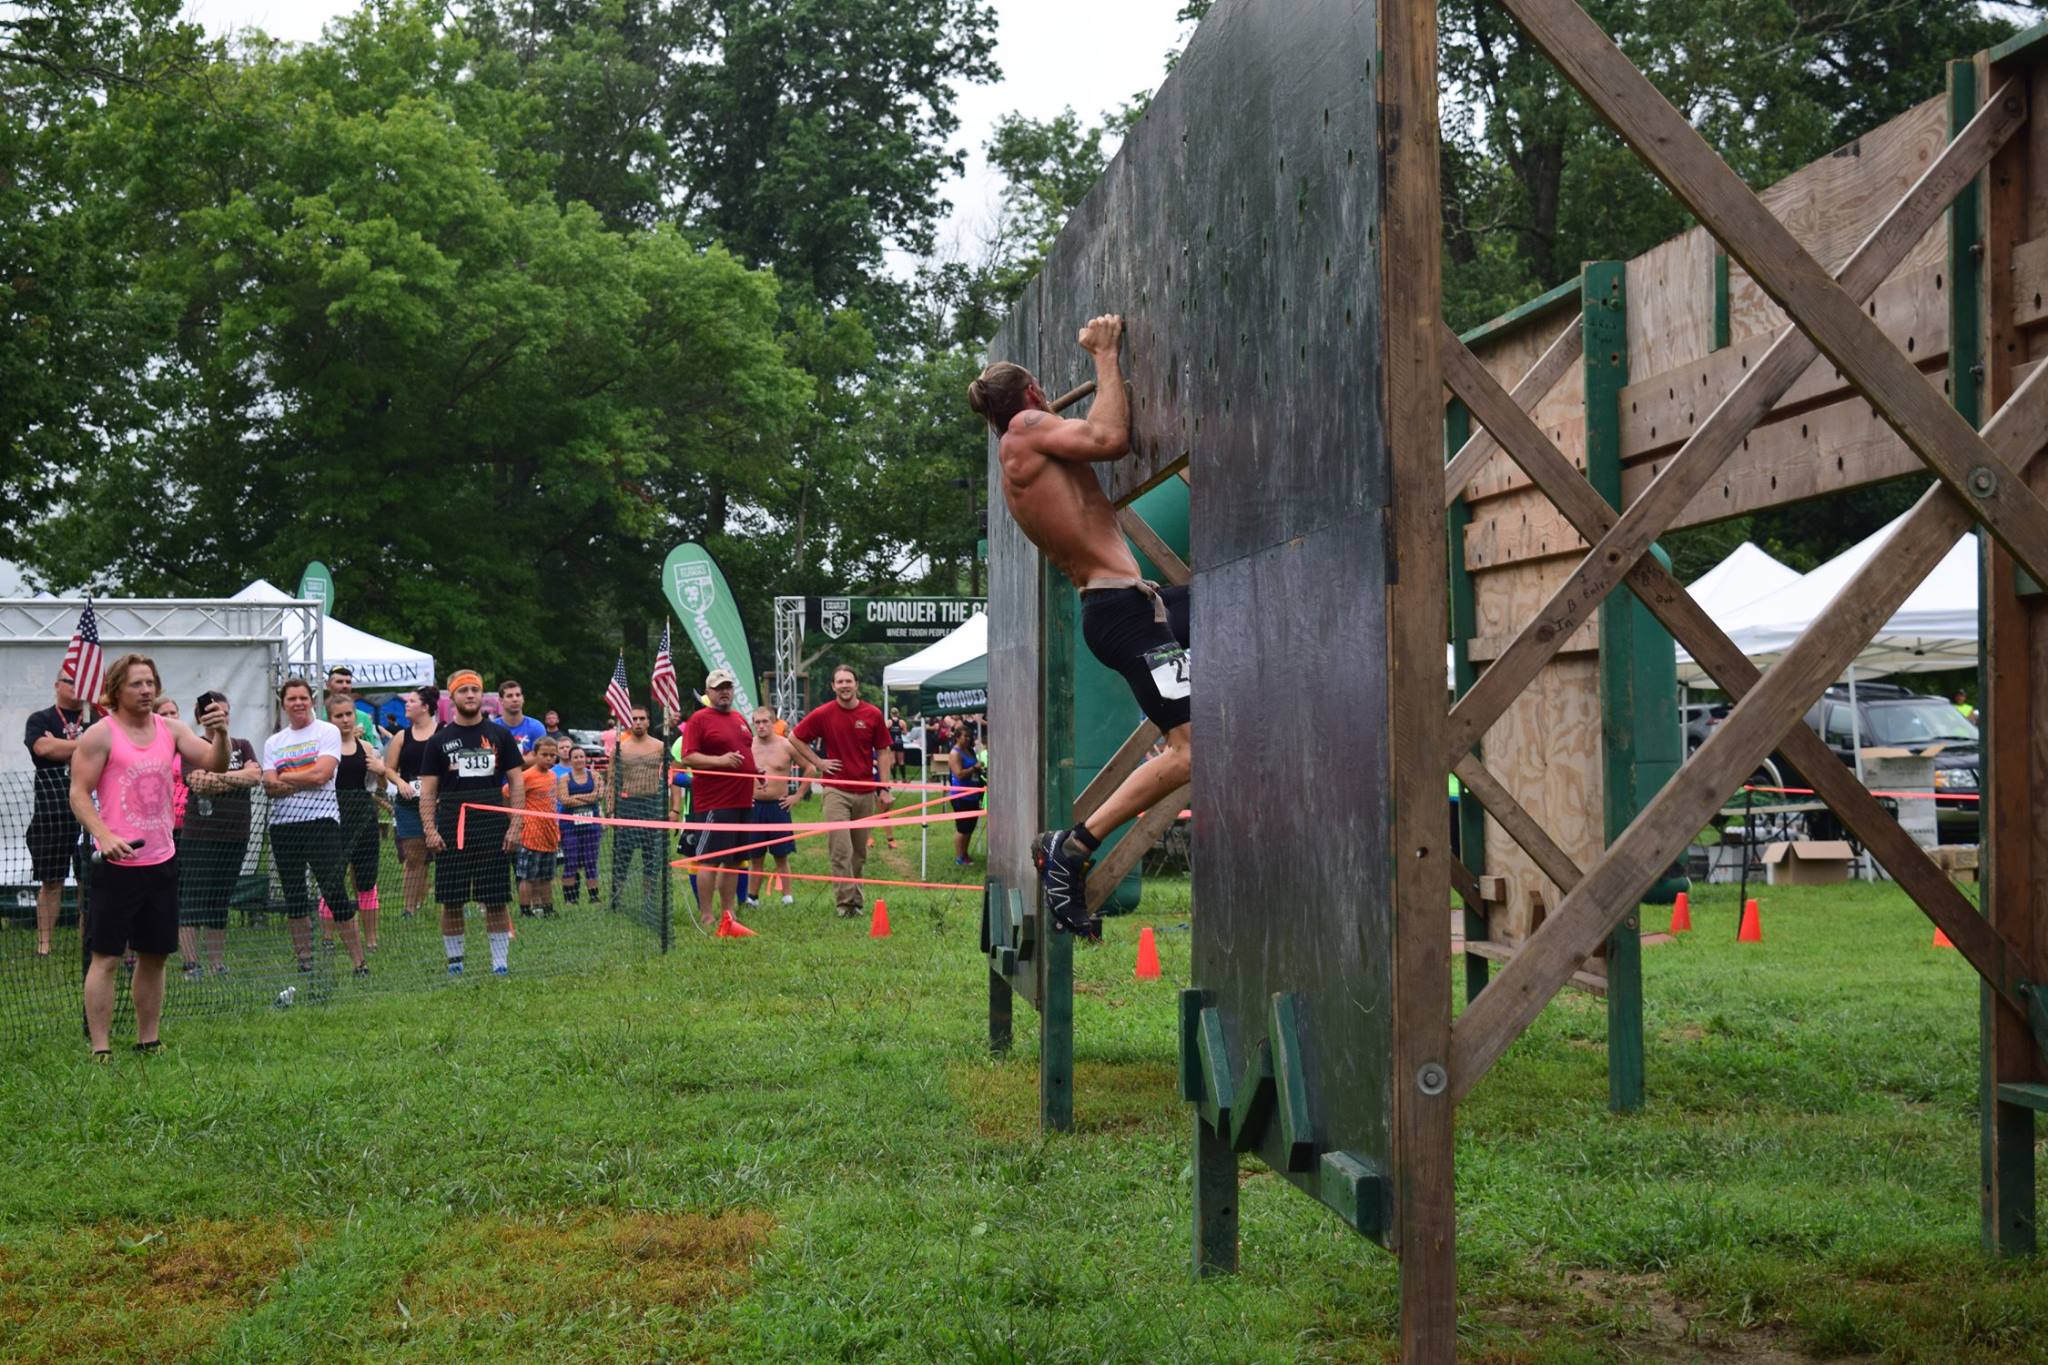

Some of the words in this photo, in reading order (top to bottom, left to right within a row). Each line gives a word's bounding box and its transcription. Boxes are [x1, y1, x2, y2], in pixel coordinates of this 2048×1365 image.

[867, 601, 936, 623] CONQUER
[940, 601, 969, 622] THE
[886, 628, 908, 637] WHERE
[908, 628, 928, 637] TOUGH
[936, 689, 986, 708] CONQUER
[465, 756, 489, 770] 319
